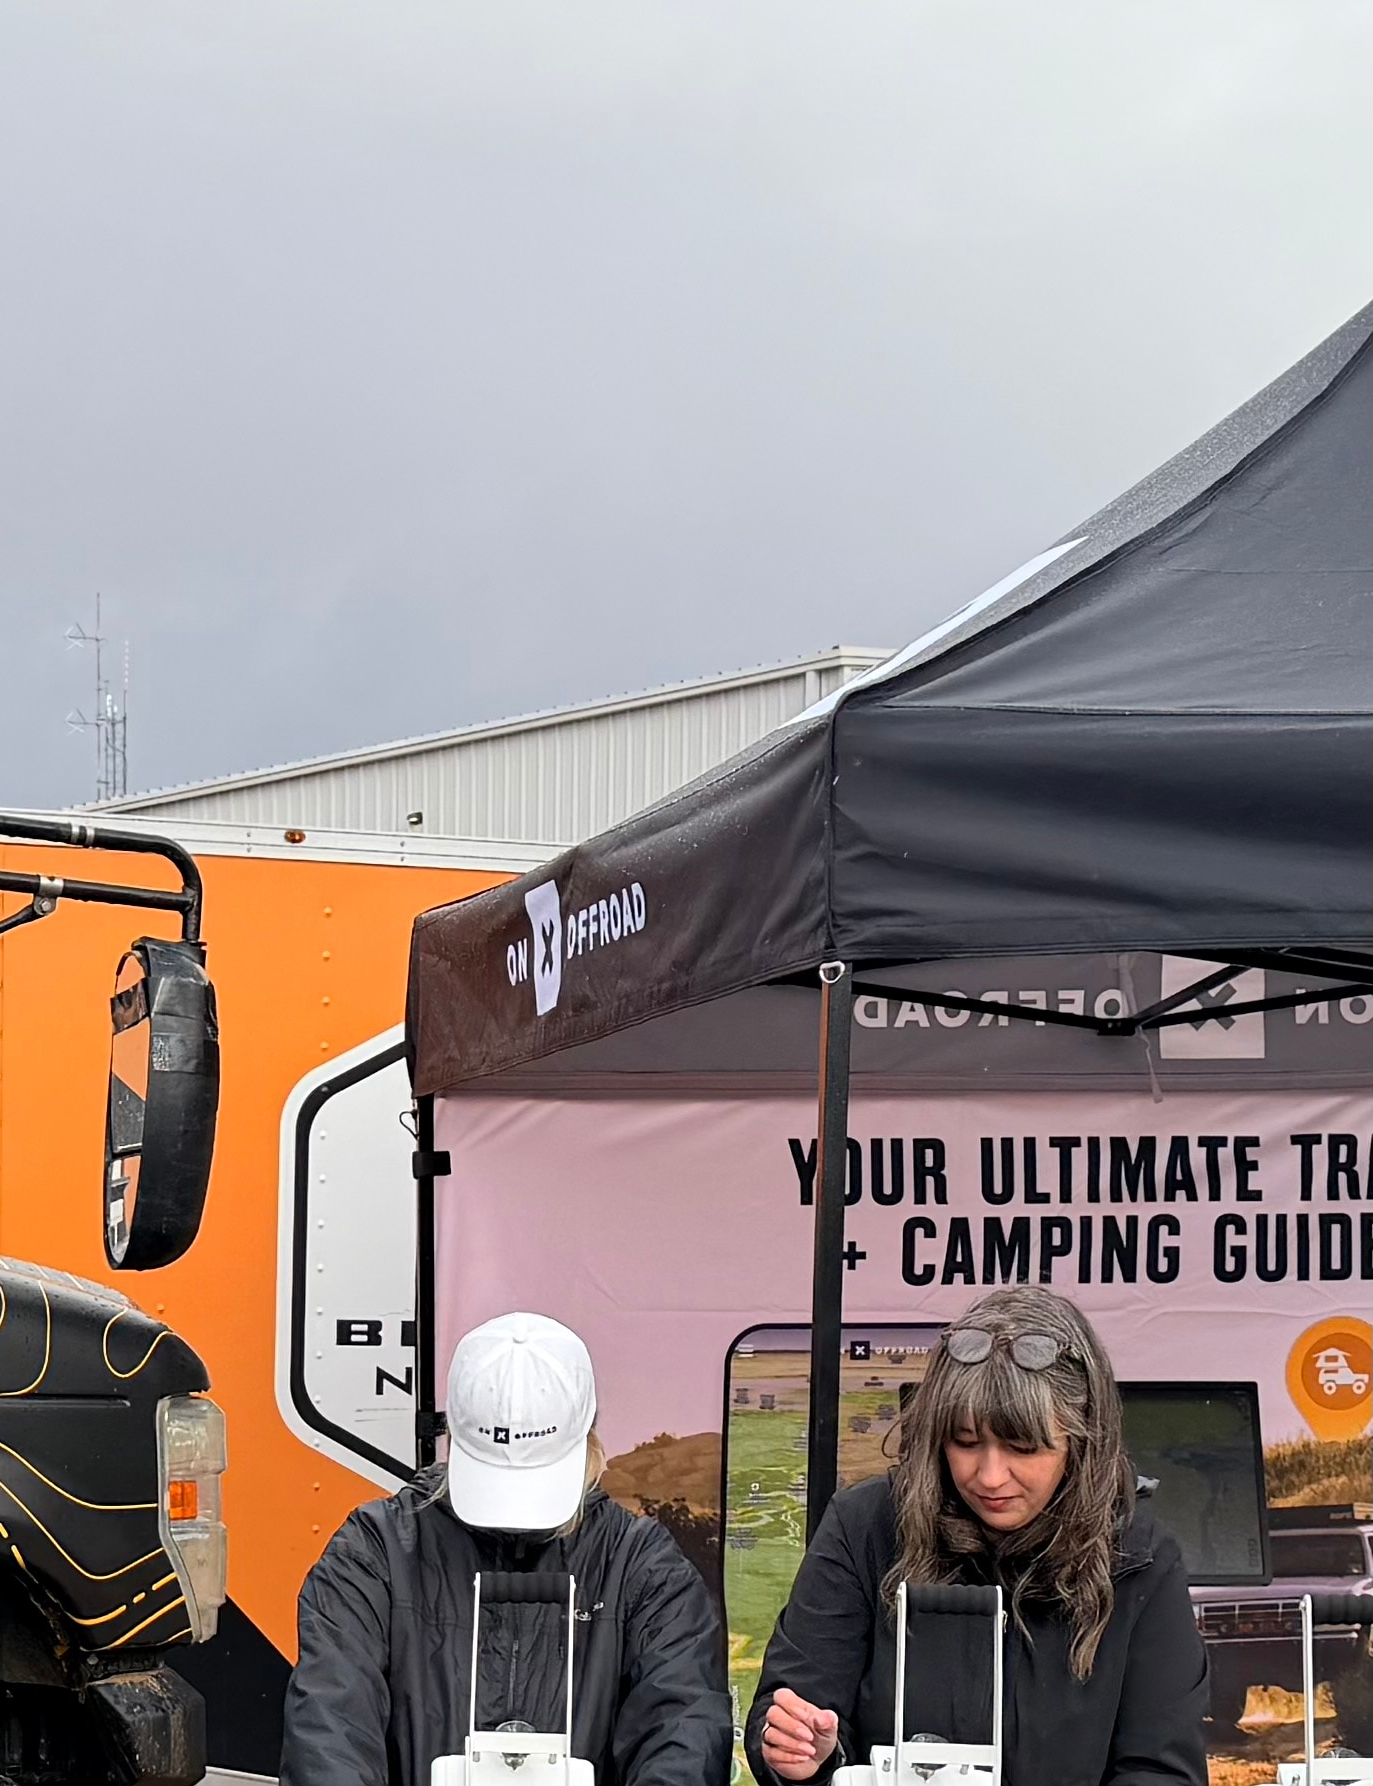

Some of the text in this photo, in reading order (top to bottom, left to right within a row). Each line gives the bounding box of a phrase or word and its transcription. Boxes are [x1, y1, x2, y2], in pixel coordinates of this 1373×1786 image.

[507, 938, 528, 986] ON
[567, 882, 646, 960] OFFROAD
[788, 1137, 947, 1206] YOUR
[980, 1136, 1263, 1205] ULTIMATE
[902, 1214, 1180, 1286] CAMPING
